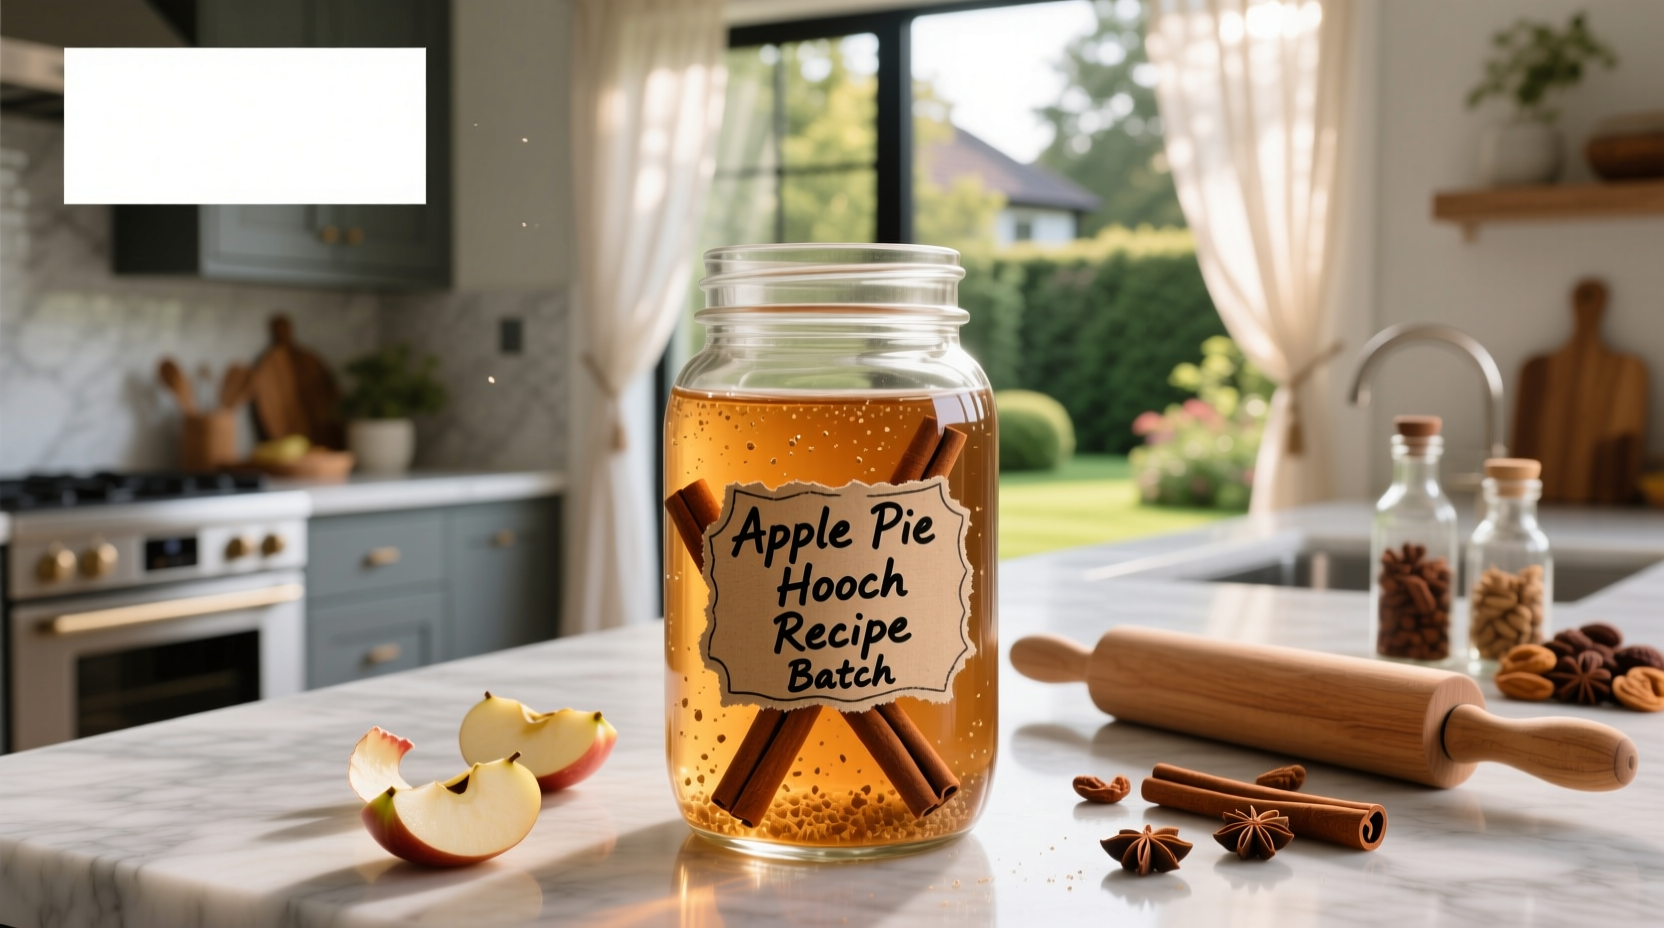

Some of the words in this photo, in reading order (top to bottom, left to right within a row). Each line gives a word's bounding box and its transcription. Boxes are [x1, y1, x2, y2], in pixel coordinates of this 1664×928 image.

[731, 505, 853, 568] Apple
[870, 501, 936, 550] Pie
[776, 556, 909, 608] Hooch
[773, 611, 912, 660] Recipe
[787, 653, 897, 693] Batch
